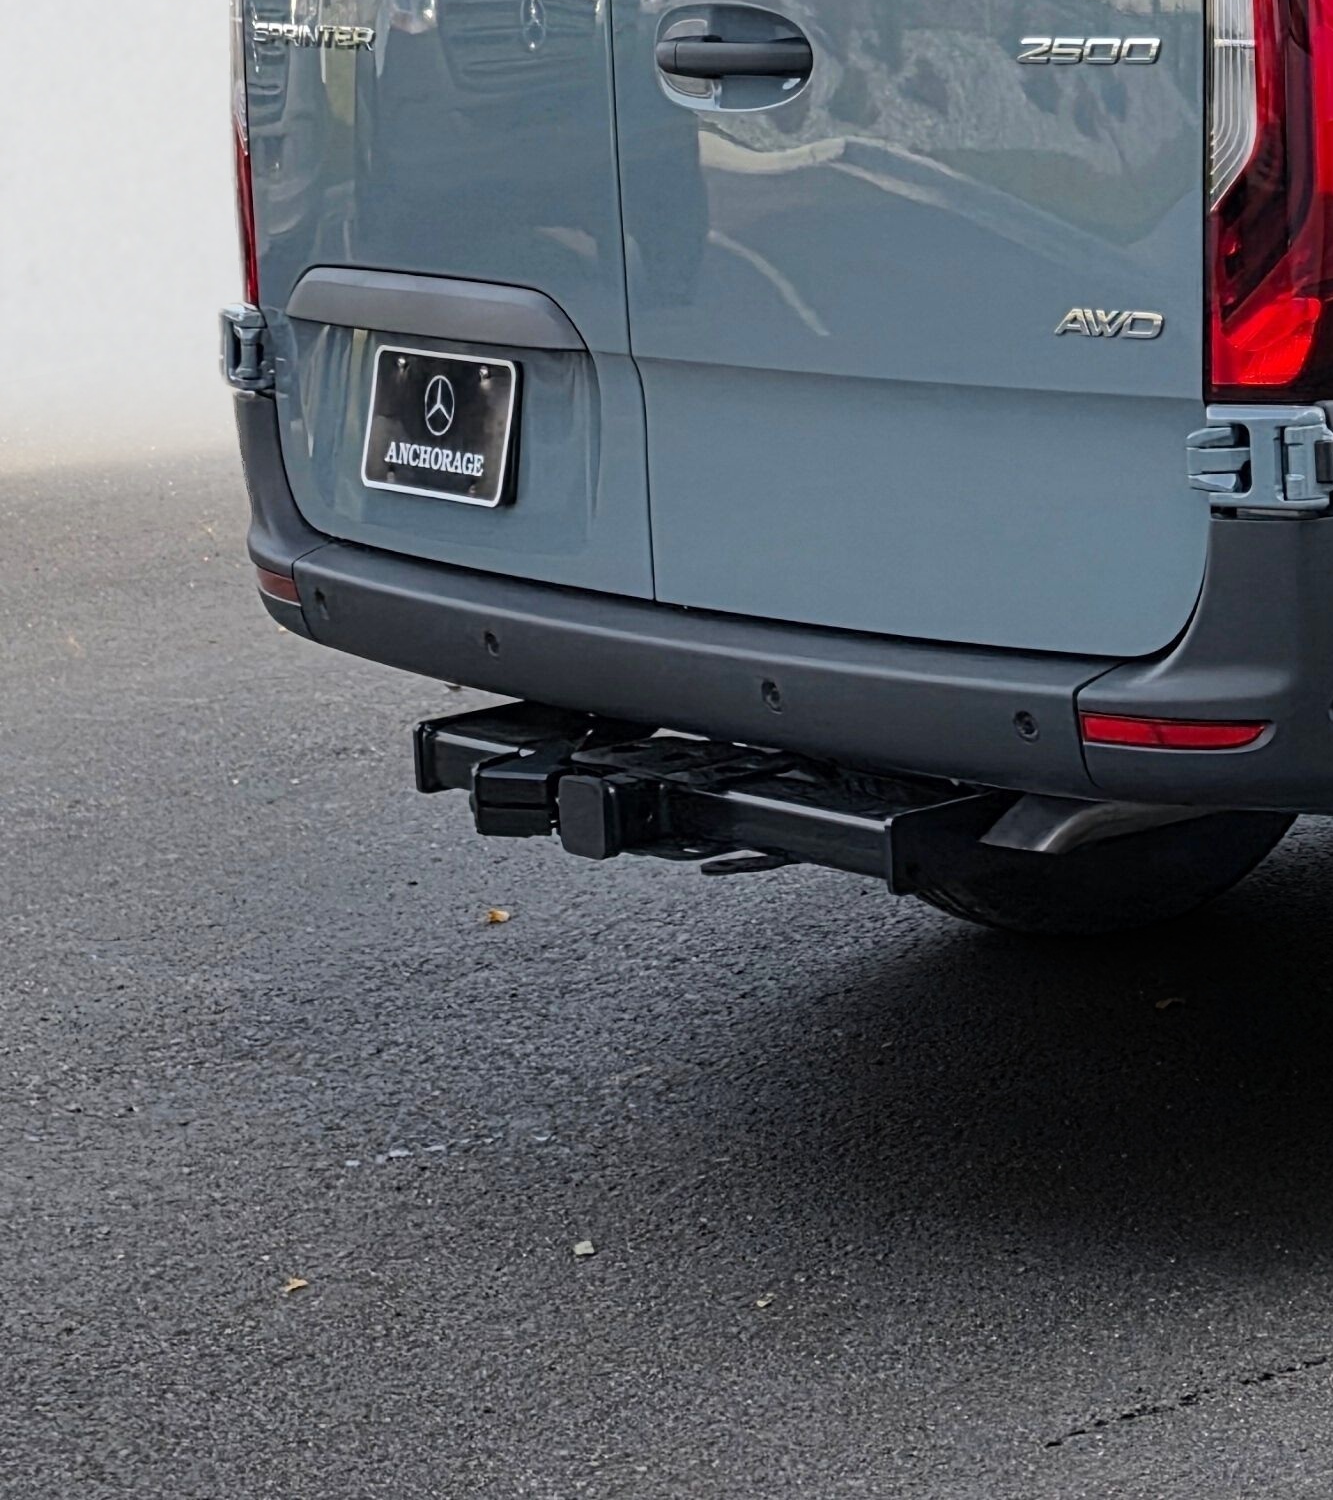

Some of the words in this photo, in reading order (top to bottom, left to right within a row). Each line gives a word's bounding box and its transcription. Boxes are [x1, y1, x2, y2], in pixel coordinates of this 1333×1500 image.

[252, 22, 375, 51] SPRINTER
[1016, 37, 1162, 66] 2500
[1054, 308, 1165, 340] AWD
[384, 441, 484, 477] ANCHORAGE
